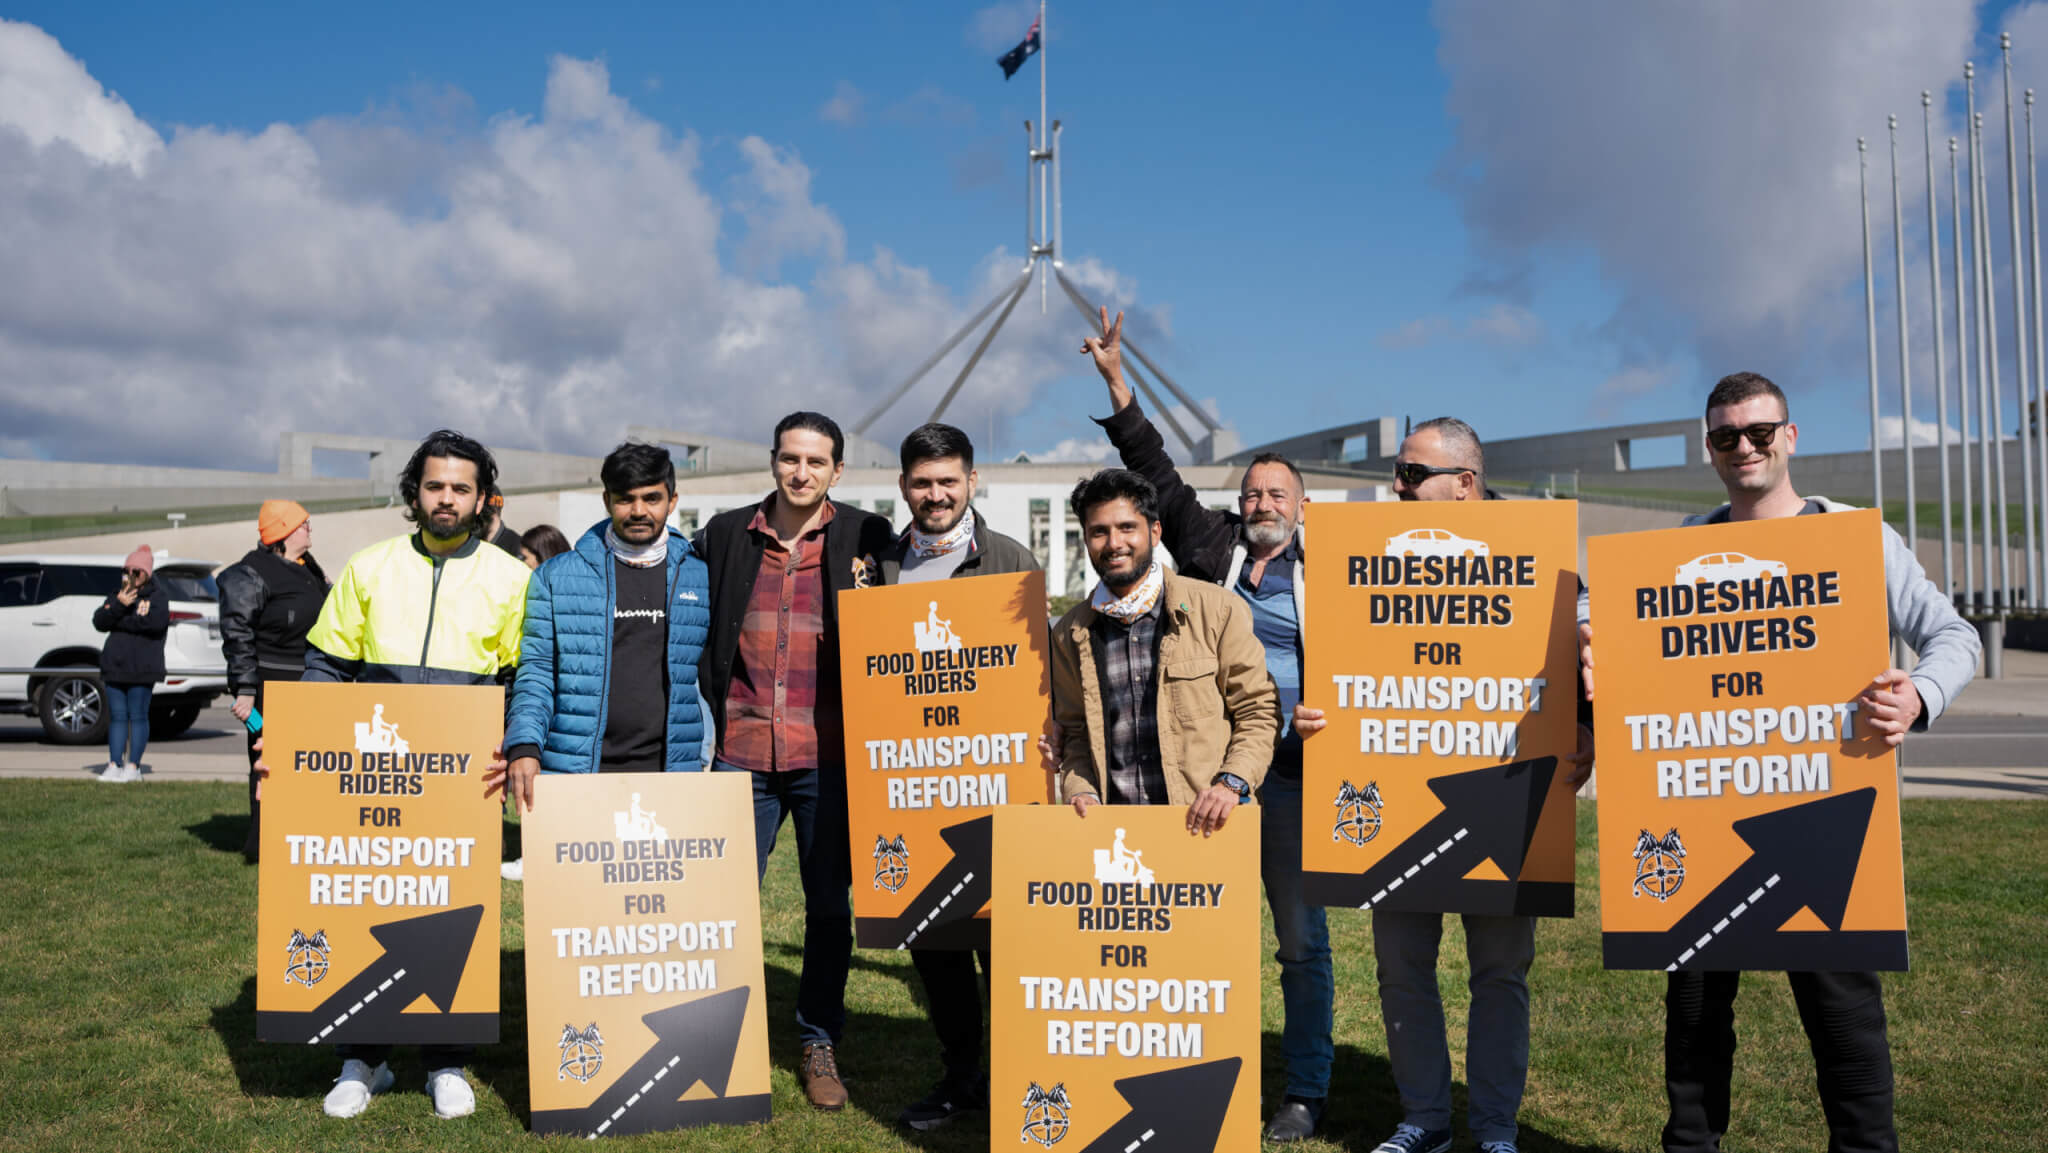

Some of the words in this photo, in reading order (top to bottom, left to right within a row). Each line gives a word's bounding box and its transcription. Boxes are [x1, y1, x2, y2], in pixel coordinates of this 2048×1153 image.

[1348, 556, 1536, 588] RIDESHARE
[1370, 594, 1513, 626] DRIVERS
[1636, 571, 1840, 620] RIDESHARE
[614, 605, 666, 624] hamp
[1662, 615, 1817, 659] DRIVERS
[866, 652, 915, 677] FOOD
[922, 644, 1018, 672] DELIVERY
[1414, 642, 1461, 665] FOR
[904, 670, 977, 697] RIDERS
[1333, 675, 1546, 712] TRANSPORT
[1711, 671, 1763, 698] FOR
[923, 706, 959, 727] FOR
[1625, 703, 1858, 751] TRANSPORT
[865, 732, 1028, 770] TRANSPORT
[1360, 719, 1518, 757] REFORM
[294, 751, 353, 772] FOOD
[361, 752, 471, 775] DELIVERY
[1657, 752, 1830, 798] REFORM
[339, 774, 423, 796] RIDERS
[888, 773, 1008, 809] REFORM
[359, 807, 401, 826] FOR
[285, 835, 475, 868] TRANSPORT
[556, 841, 615, 864] FOOD
[623, 838, 726, 861] DELIVERY
[603, 861, 685, 885] RIDERS
[310, 874, 449, 906] REFORM
[625, 894, 665, 915] FOR
[1027, 881, 1093, 906] FOOD
[1102, 882, 1224, 908] DELIVERY
[1078, 907, 1172, 932] RIDERS
[552, 920, 736, 958] TRANSPORT
[1101, 945, 1147, 968] FOR
[579, 959, 717, 997] REFORM
[1020, 976, 1231, 1013] TRANSPORT
[1047, 1020, 1202, 1058] REFORM
